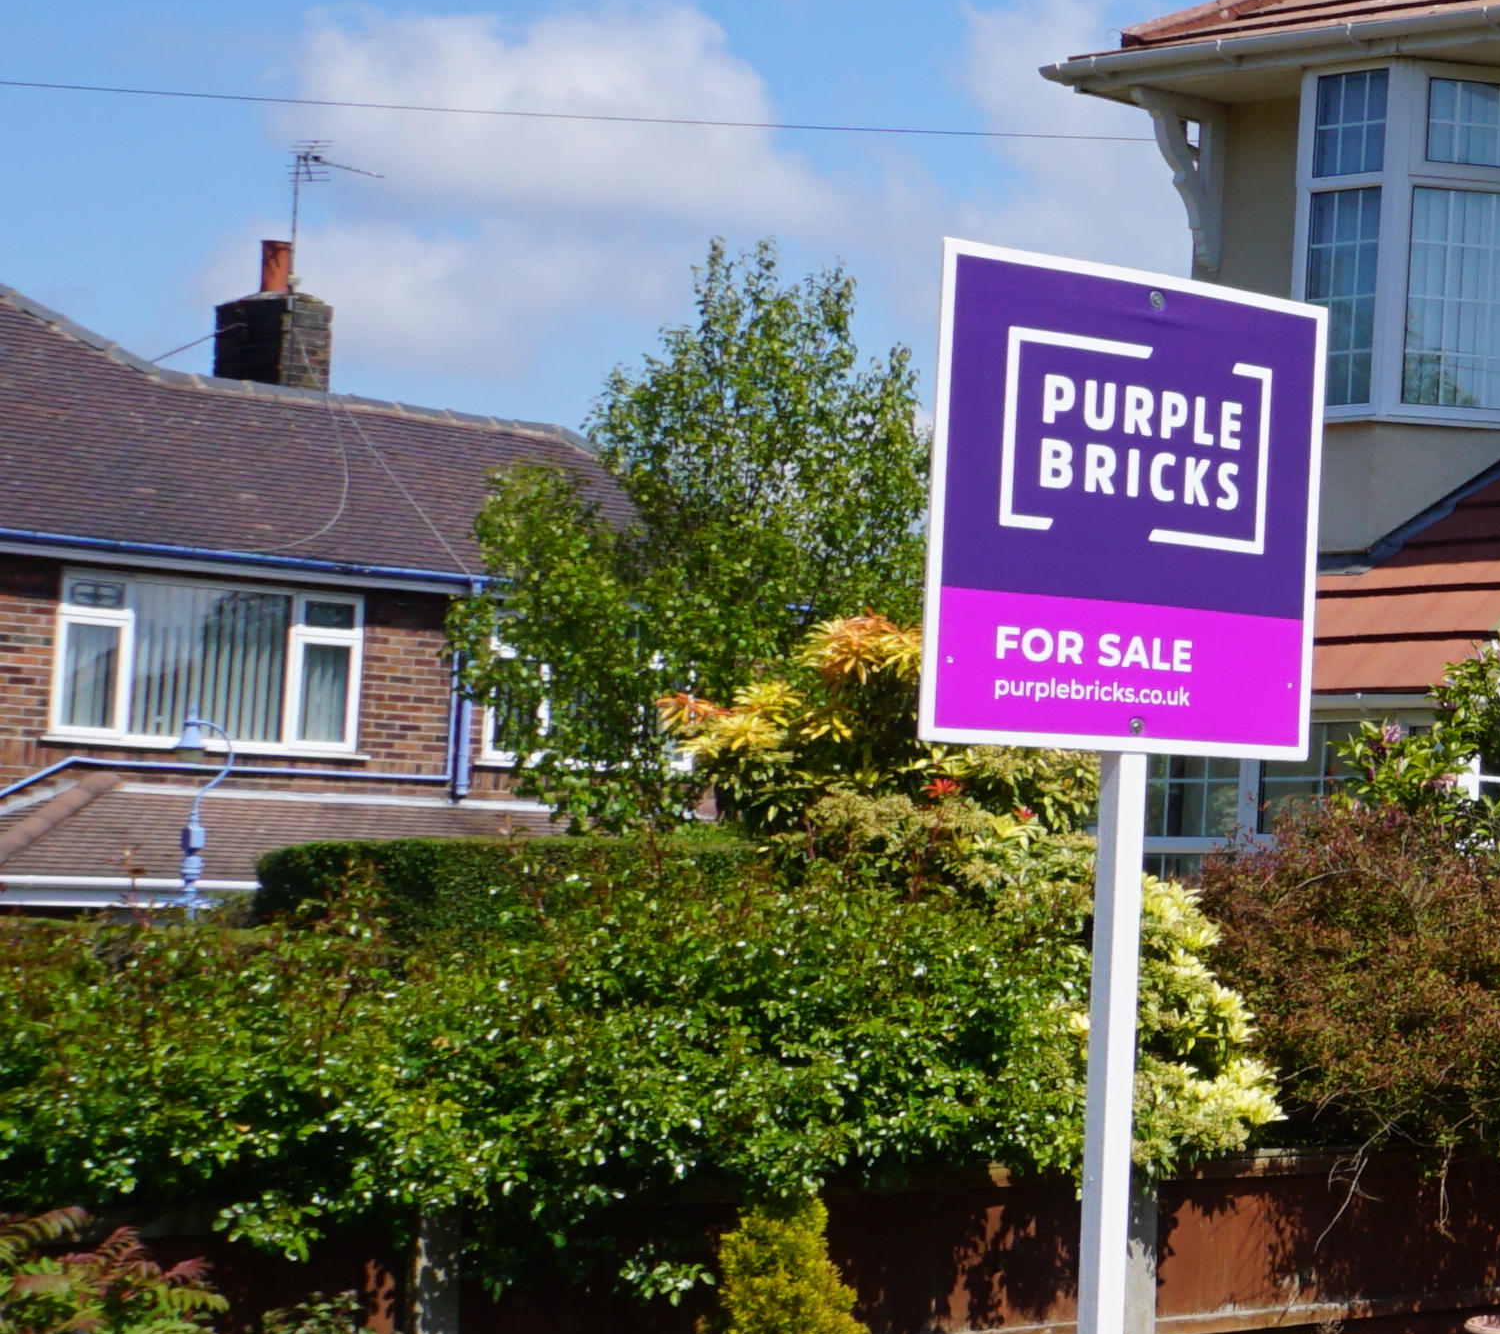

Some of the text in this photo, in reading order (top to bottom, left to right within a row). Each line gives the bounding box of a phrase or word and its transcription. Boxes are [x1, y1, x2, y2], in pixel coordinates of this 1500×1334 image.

[1042, 373, 1243, 451] PURPLE
[1039, 437, 1239, 511] BRICKS
[995, 625, 1193, 673] FOR SALE
[994, 677, 1190, 707] purplebricks.co.uk
